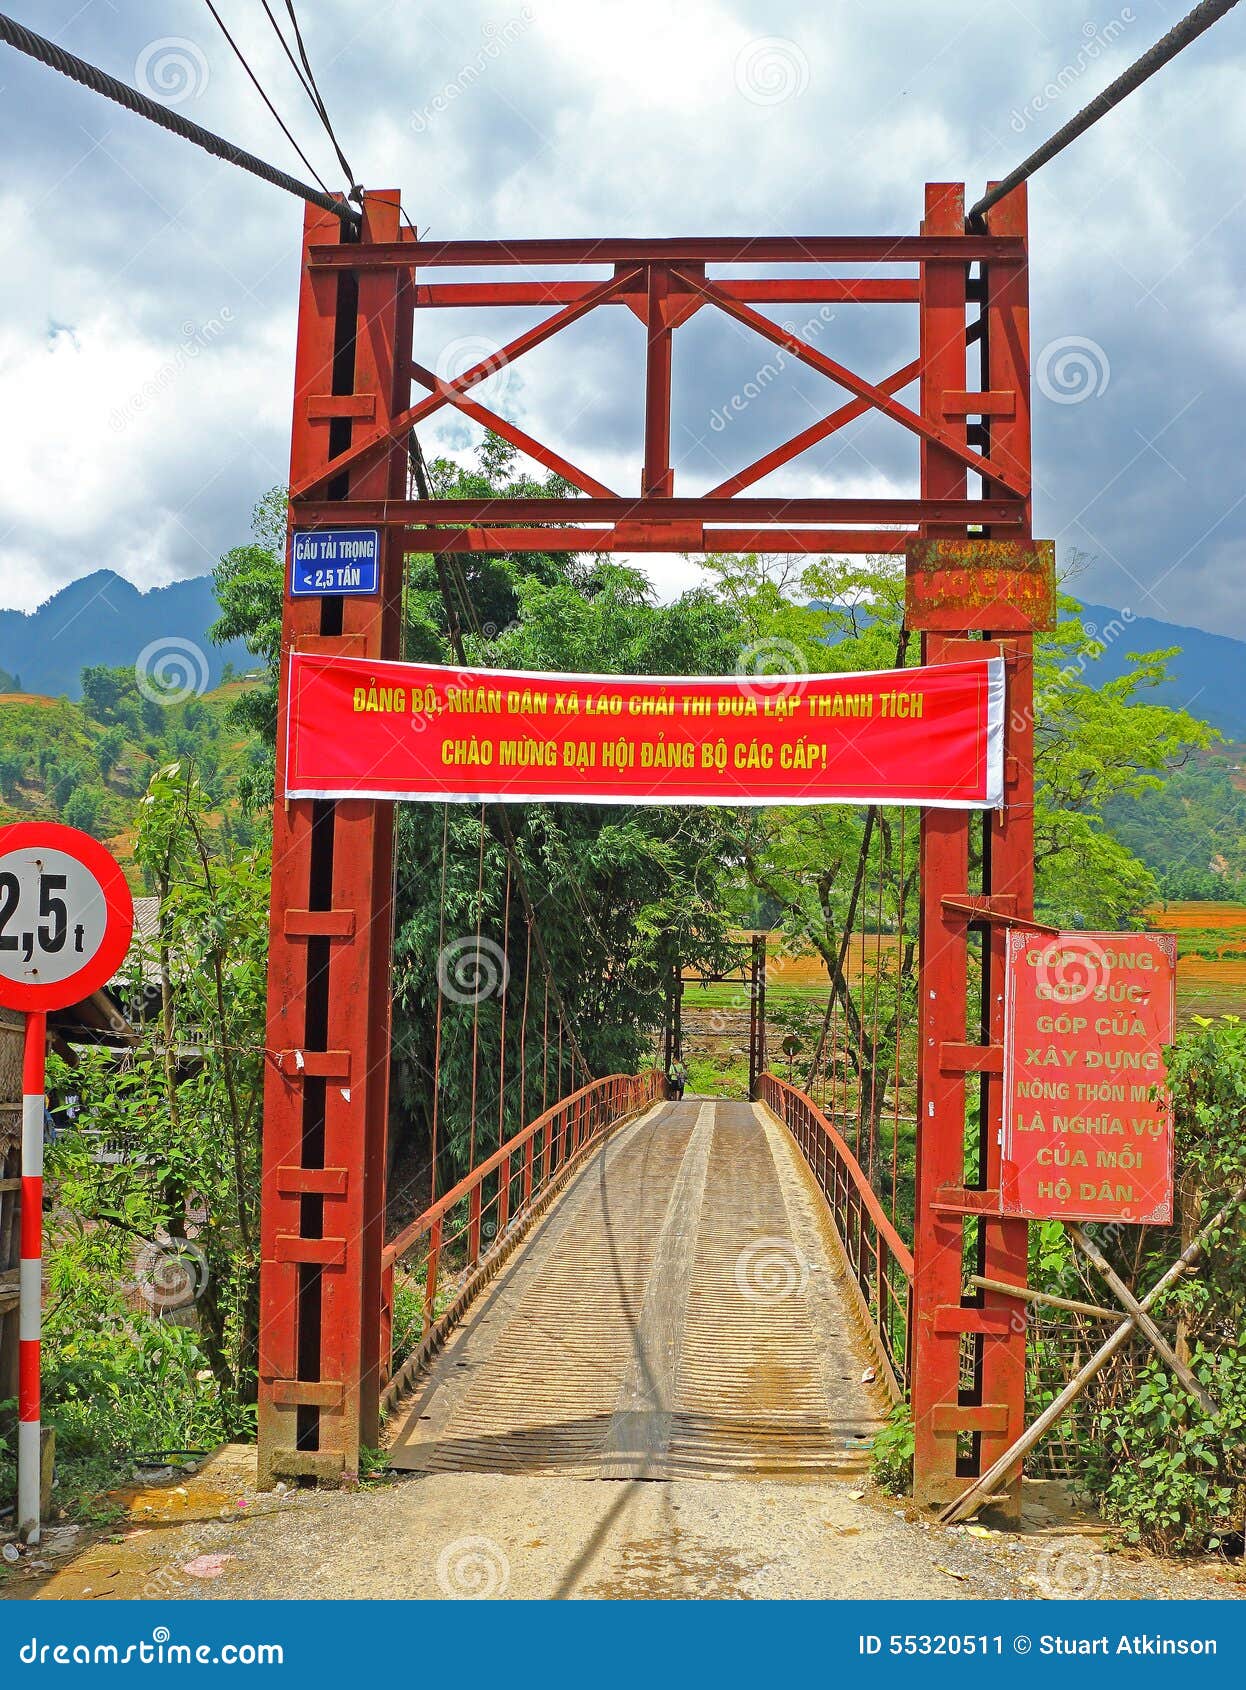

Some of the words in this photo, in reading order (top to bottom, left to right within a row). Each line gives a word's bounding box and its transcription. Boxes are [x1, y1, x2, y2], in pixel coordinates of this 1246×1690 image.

[297, 537, 318, 560] CẦU
[321, 535, 337, 559] TẢI
[339, 541, 374, 562] TRỌNG
[315, 569, 334, 589] 2,5
[337, 563, 360, 586] TẤN
[353, 677, 406, 713] ĐẢNG
[411, 684, 443, 719] BỘ,
[448, 686, 501, 713] NHÂN
[507, 688, 548, 715] DÂN
[553, 690, 580, 715] XÃ
[585, 694, 622, 715] LAO
[628, 687, 675, 716] CHẢI
[681, 695, 711, 716] THI
[717, 696, 757, 717] ĐUA
[764, 691, 801, 722] LẬP
[808, 689, 873, 718] THÀNH
[879, 688, 924, 719] TÍCH
[441, 735, 493, 766] CHÀO
[499, 734, 557, 767] MỪNG
[563, 740, 597, 773] ĐẠI
[602, 736, 635, 773] HỘI
[641, 731, 695, 768] ĐẢNG
[701, 738, 728, 773] BỘ
[734, 739, 773, 769] CÁC
[780, 735, 828, 769] CẤP!
[1026, 945, 1077, 968] GÓP
[1084, 948, 1161, 973] CÔNG,
[1035, 979, 1086, 1001] GÓP
[1036, 1012, 1087, 1034] GÓP
[1095, 1010, 1148, 1037] CỦA
[1024, 1044, 1078, 1067] XÂY
[1017, 1077, 1070, 1100] NÔNG
[1075, 1079, 1126, 1103] THÔN
[1017, 1111, 1046, 1133] LÀ
[1052, 1113, 1125, 1136] NGHĨA
[1130, 1117, 1165, 1142] VỤ
[1036, 1141, 1089, 1168] CỦA
[1096, 1142, 1143, 1170] MỖI
[1037, 1178, 1072, 1205] HỘ
[1079, 1180, 1140, 1203] DÂN.
